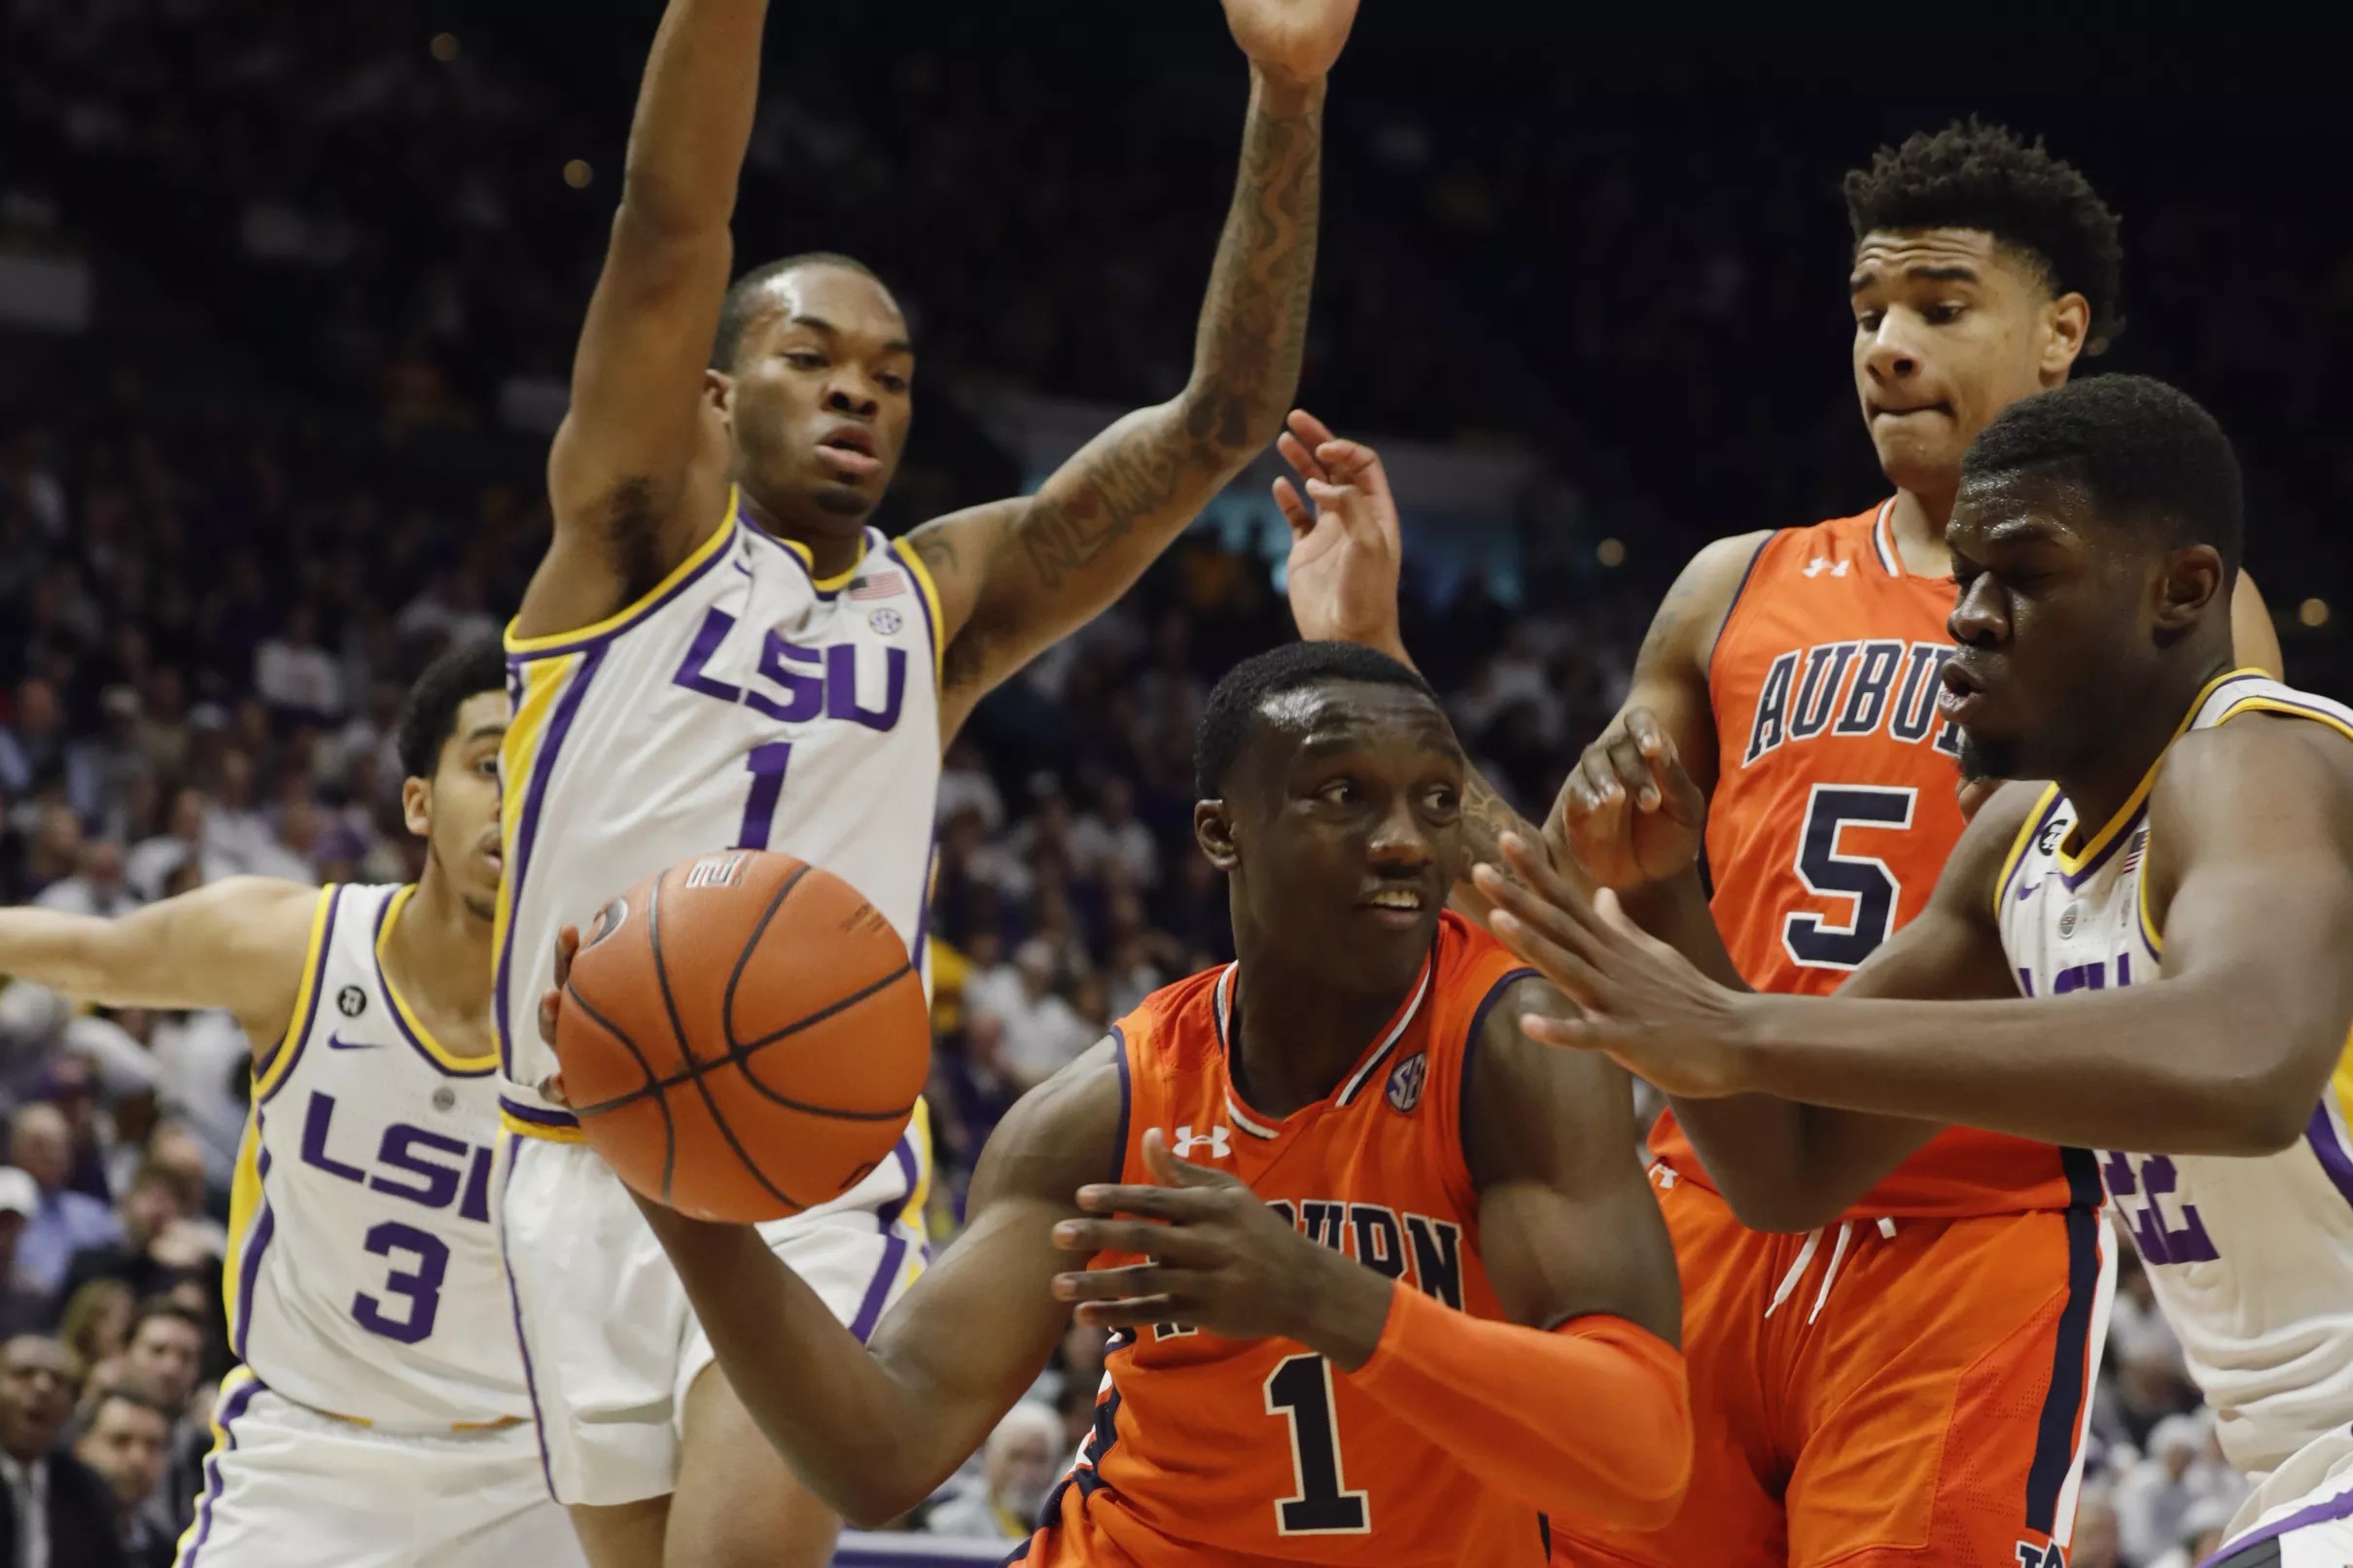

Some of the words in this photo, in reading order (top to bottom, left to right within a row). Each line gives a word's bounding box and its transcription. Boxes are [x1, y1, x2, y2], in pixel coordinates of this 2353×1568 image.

[673, 607, 908, 733] LSU
[1741, 639, 1963, 770] AUBU
[727, 742, 792, 851] 1
[1781, 782, 1918, 971] 5
[1388, 1053, 1426, 1110] SE
[351, 1220, 450, 1344] 3
[1264, 1351, 1372, 1537] 1
